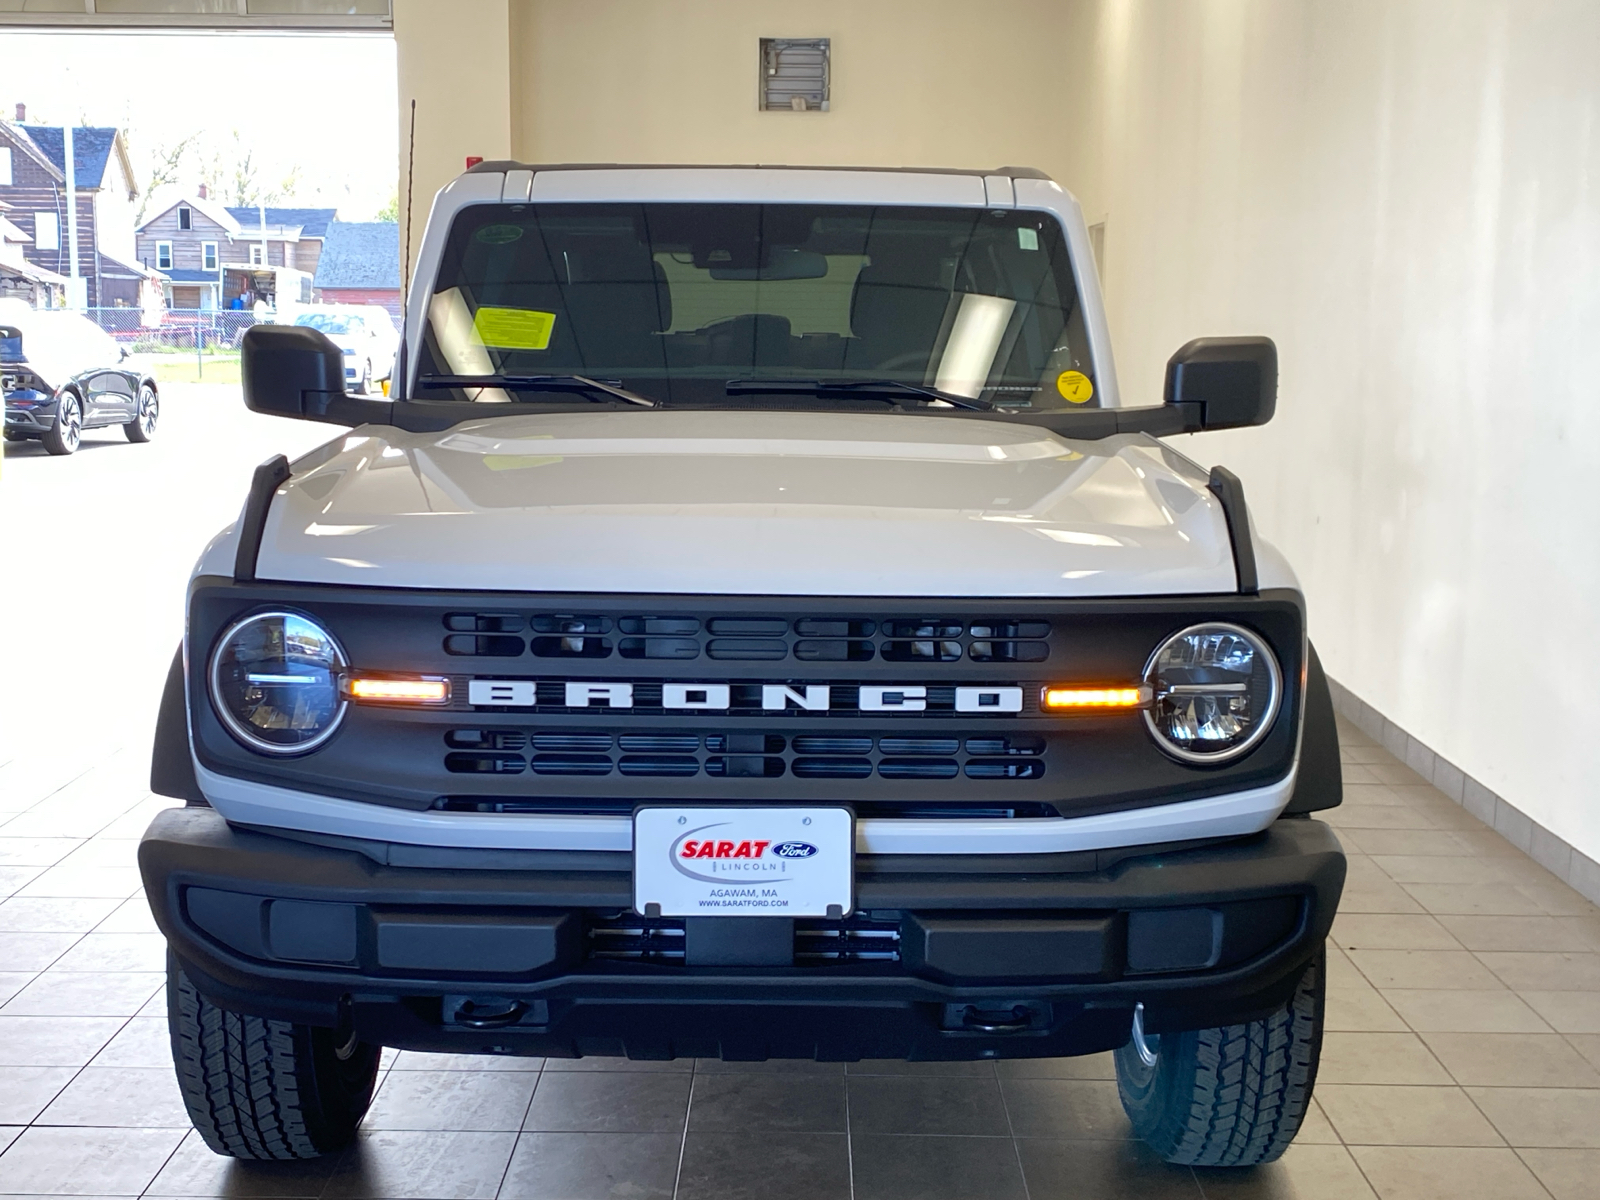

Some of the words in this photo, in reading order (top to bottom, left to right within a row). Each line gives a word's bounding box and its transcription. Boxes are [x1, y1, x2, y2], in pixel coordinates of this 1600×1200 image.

[469, 679, 1023, 712] BRONCO
[680, 840, 771, 859] SARAT
[778, 842, 811, 858] Ford
[721, 863, 777, 871] LINCOLN
[709, 889, 759, 898] AGAWAM,
[761, 889, 778, 897] MA
